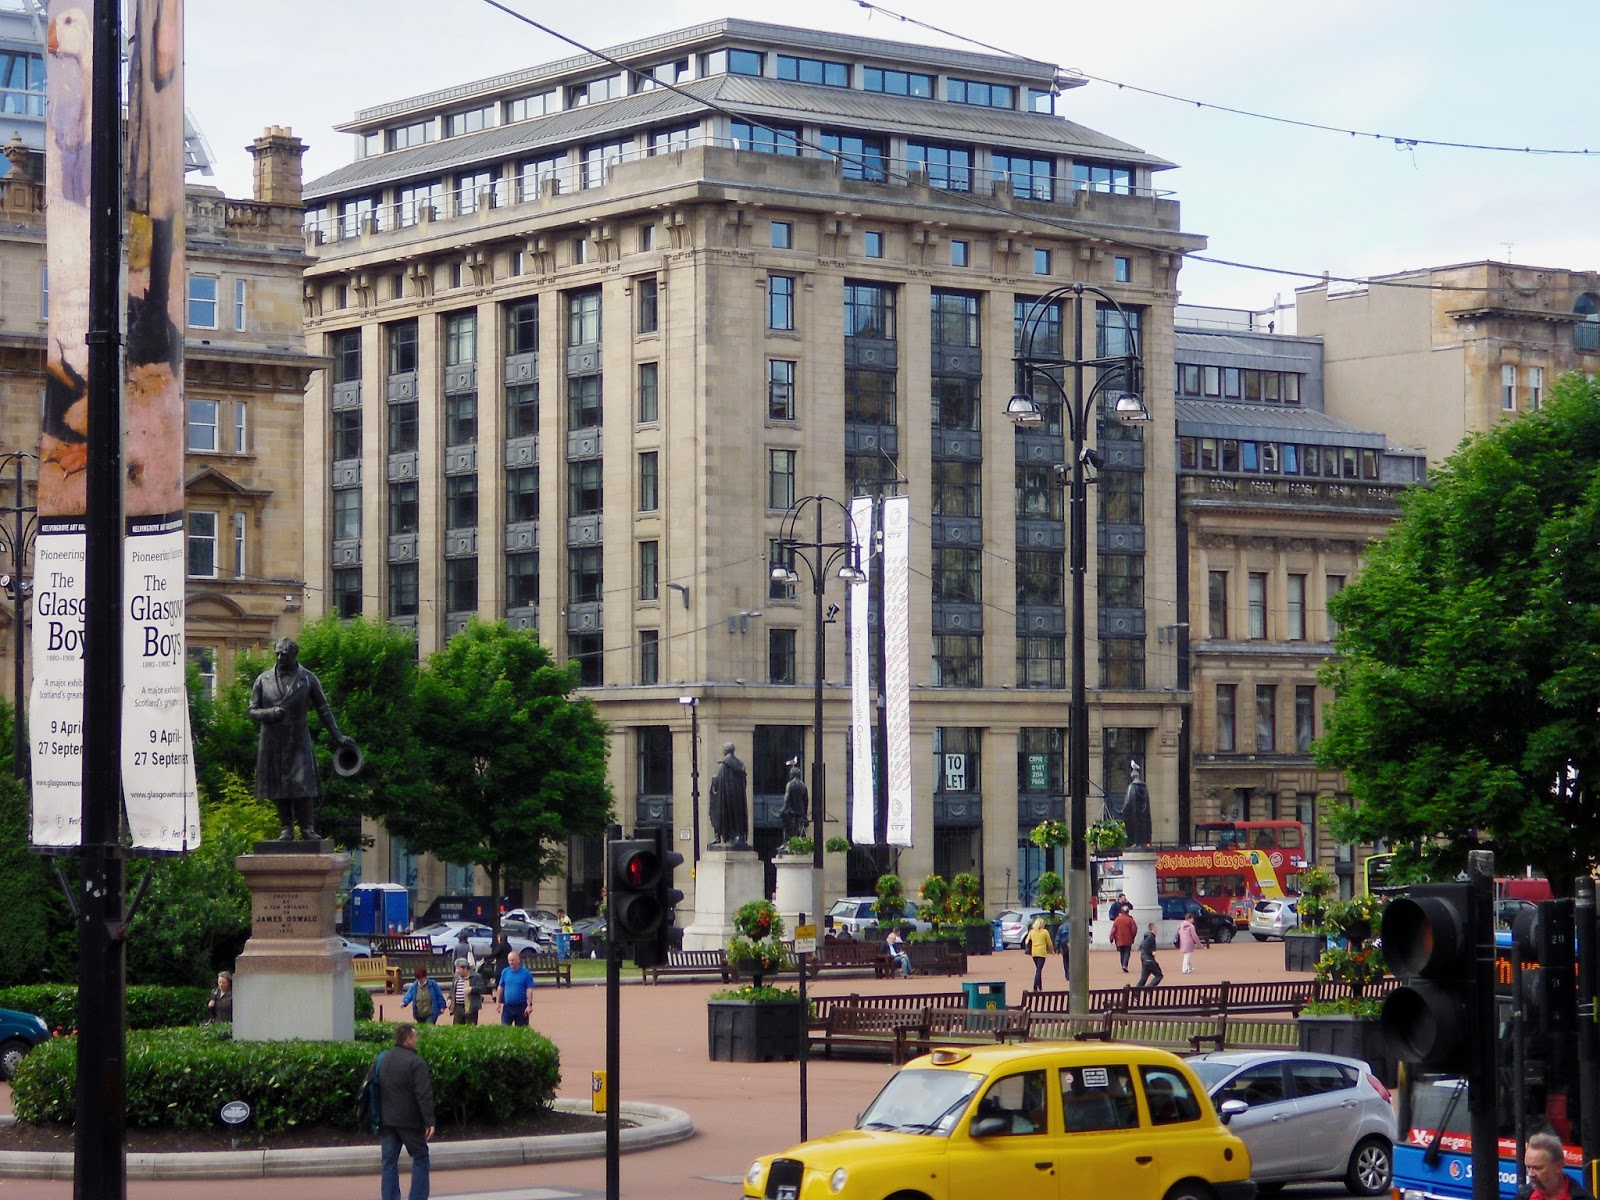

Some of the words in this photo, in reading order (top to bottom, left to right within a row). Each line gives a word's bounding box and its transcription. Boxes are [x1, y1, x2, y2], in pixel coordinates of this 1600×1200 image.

[40, 550, 85, 561] Pioneering
[51, 572, 74, 588] The
[144, 575, 167, 591] The
[143, 626, 181, 664] Boys
[44, 679, 48, 687] A
[50, 680, 66, 688] major
[51, 721, 57, 734] 9
[149, 729, 157, 743] 9
[38, 741, 49, 755] 27
[134, 752, 148, 766] 27
[947, 756, 962, 770] TO
[946, 775, 963, 789] LET
[1213, 851, 1252, 869] Glasgow
